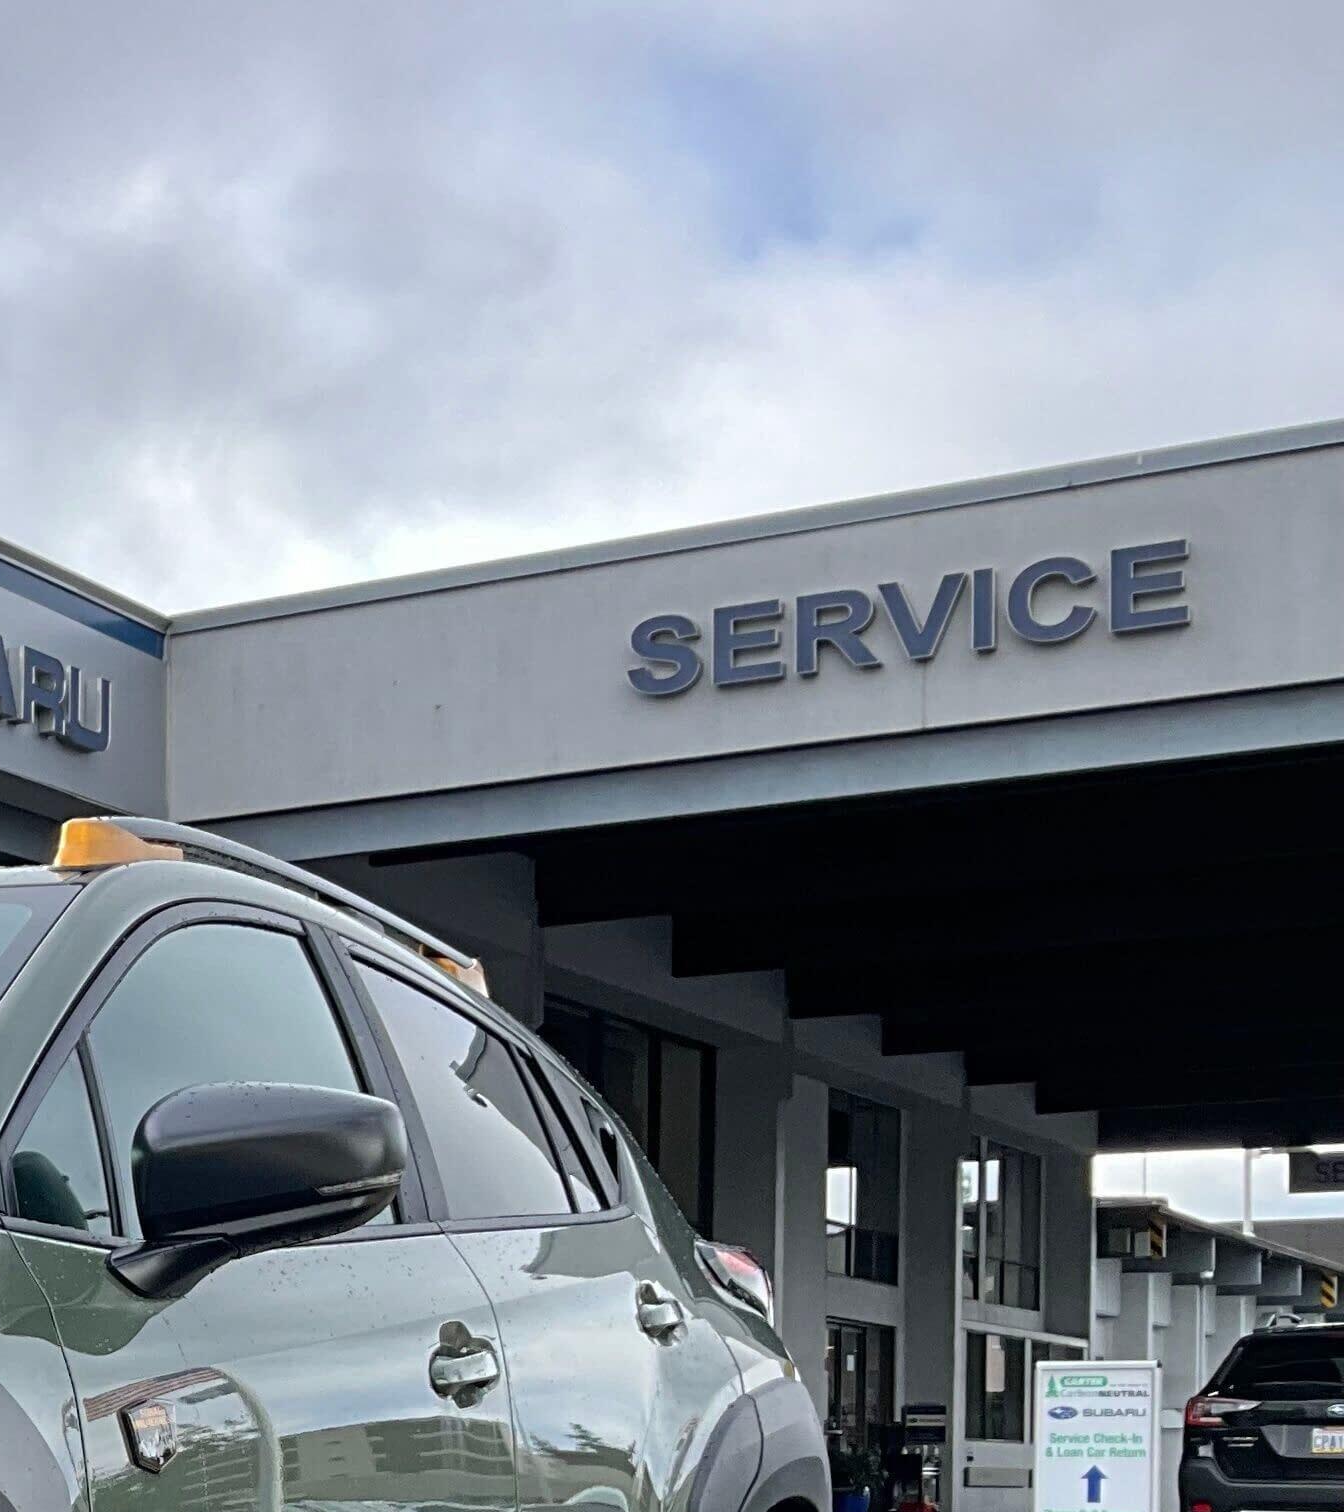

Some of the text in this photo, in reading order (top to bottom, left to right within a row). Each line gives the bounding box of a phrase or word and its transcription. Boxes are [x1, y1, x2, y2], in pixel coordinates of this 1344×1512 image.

[626, 539, 1191, 698] SERVICE
[1082, 1408, 1147, 1417] SUBARU
[1050, 1432, 1143, 1444] Service Check-In
[1057, 1447, 1083, 1457] Loan
[1087, 1447, 1105, 1457] Car
[1109, 1447, 1146, 1457] Return
